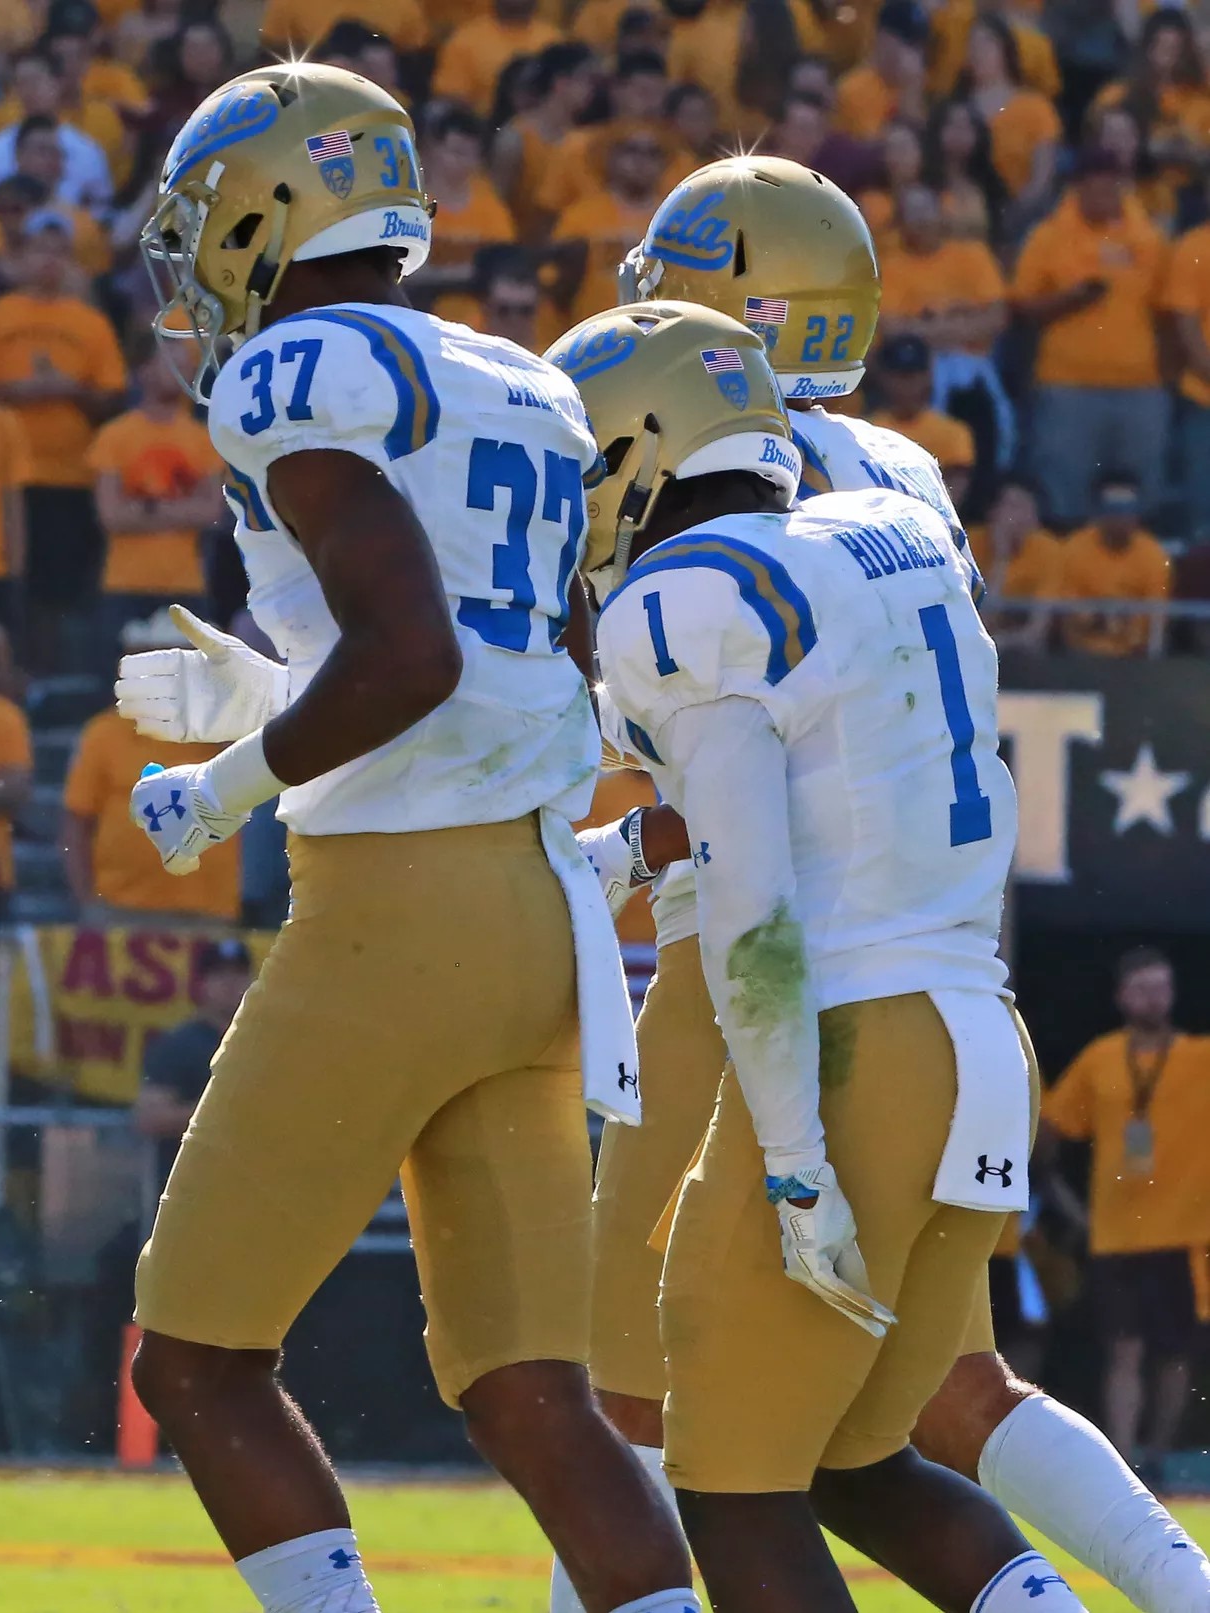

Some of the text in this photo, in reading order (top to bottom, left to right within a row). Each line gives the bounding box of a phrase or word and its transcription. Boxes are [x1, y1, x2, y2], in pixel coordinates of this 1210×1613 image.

[801, 313, 855, 362] 22
[240, 339, 324, 436] 37
[786, 377, 848, 397] Bruins
[456, 437, 585, 654] 37
[643, 591, 679, 677] 1
[918, 604, 992, 847] 1
[631, 837, 643, 859] YOUR
[634, 860, 648, 875] BEST
